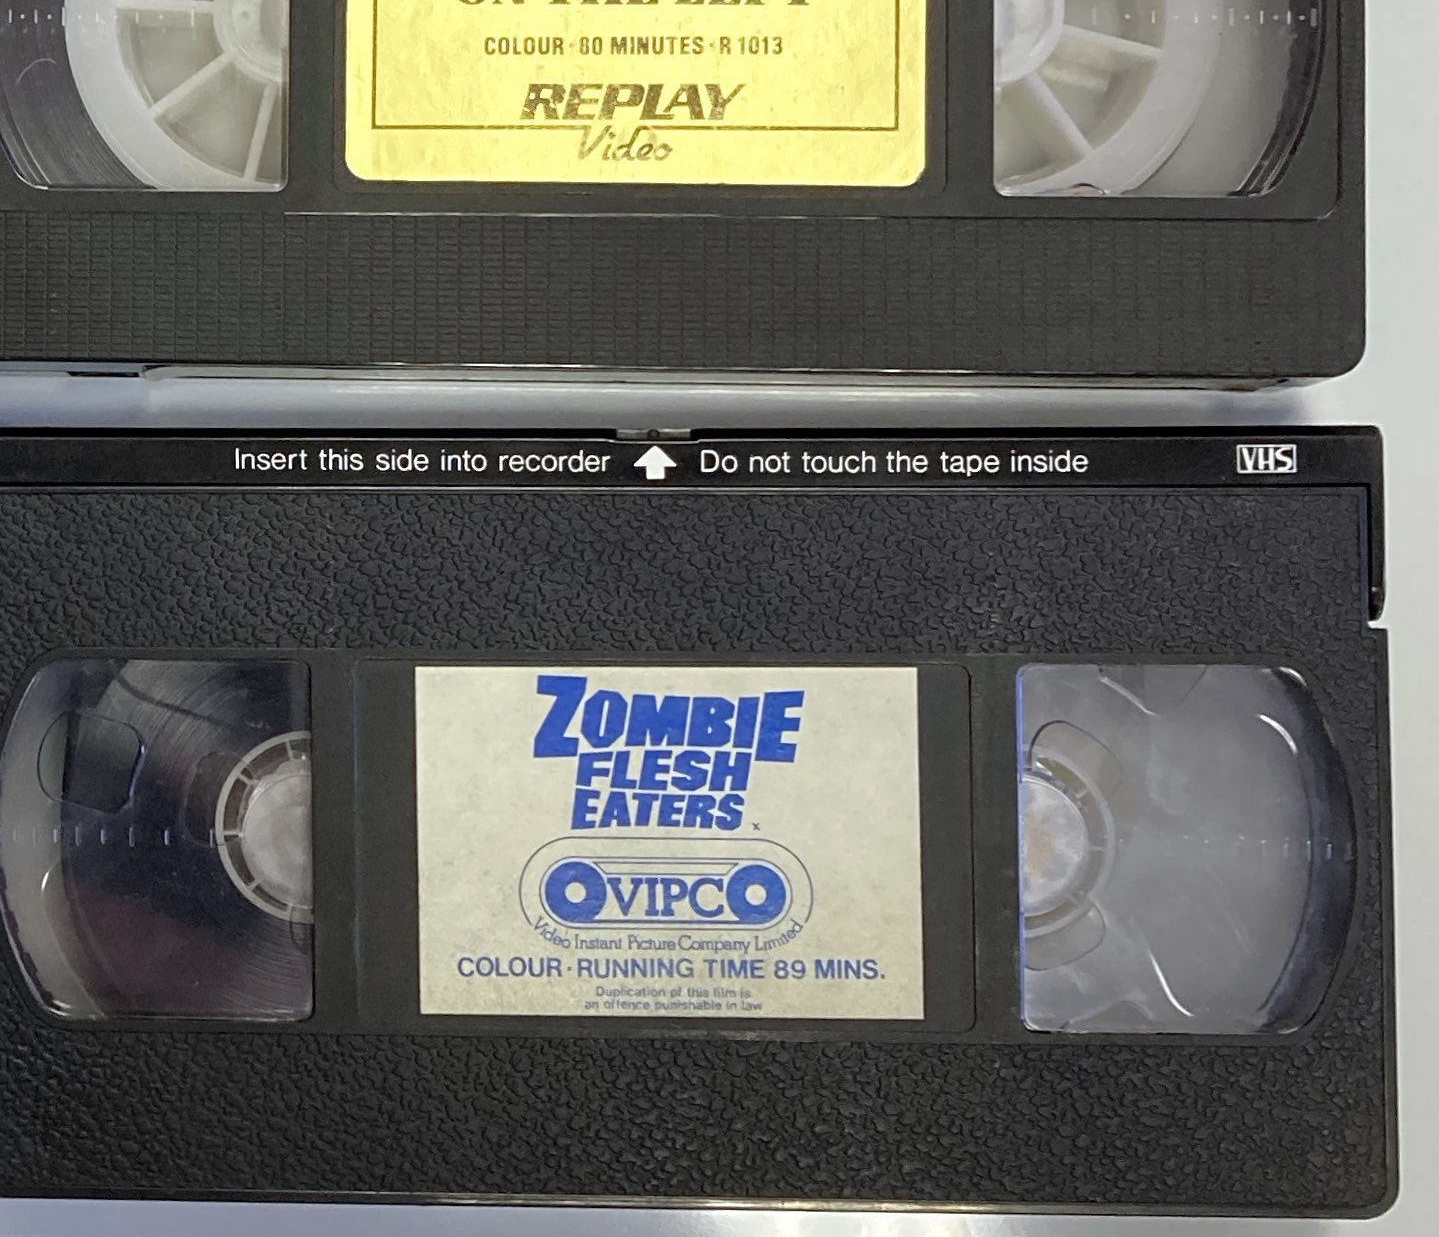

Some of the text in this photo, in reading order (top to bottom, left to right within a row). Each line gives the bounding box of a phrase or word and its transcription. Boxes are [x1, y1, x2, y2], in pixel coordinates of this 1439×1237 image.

[484, 37, 564, 55] COLOUR
[611, 36, 703, 55] MINUTES
[520, 84, 745, 120] REPLAY
[576, 124, 673, 162] Video
[235, 448, 610, 472] Insert this side into recorder
[701, 450, 1088, 476] Do not touch the tape inside
[1240, 446, 1293, 472] VHS
[532, 674, 805, 763] ZOMBIE
[574, 751, 753, 792] FLESH
[570, 788, 746, 832] EATERS
[532, 916, 804, 955] Video Instant Picture Company Limited
[703, 959, 765, 979] TIME
[774, 960, 806, 980] 89
[814, 959, 885, 980] MINS.
